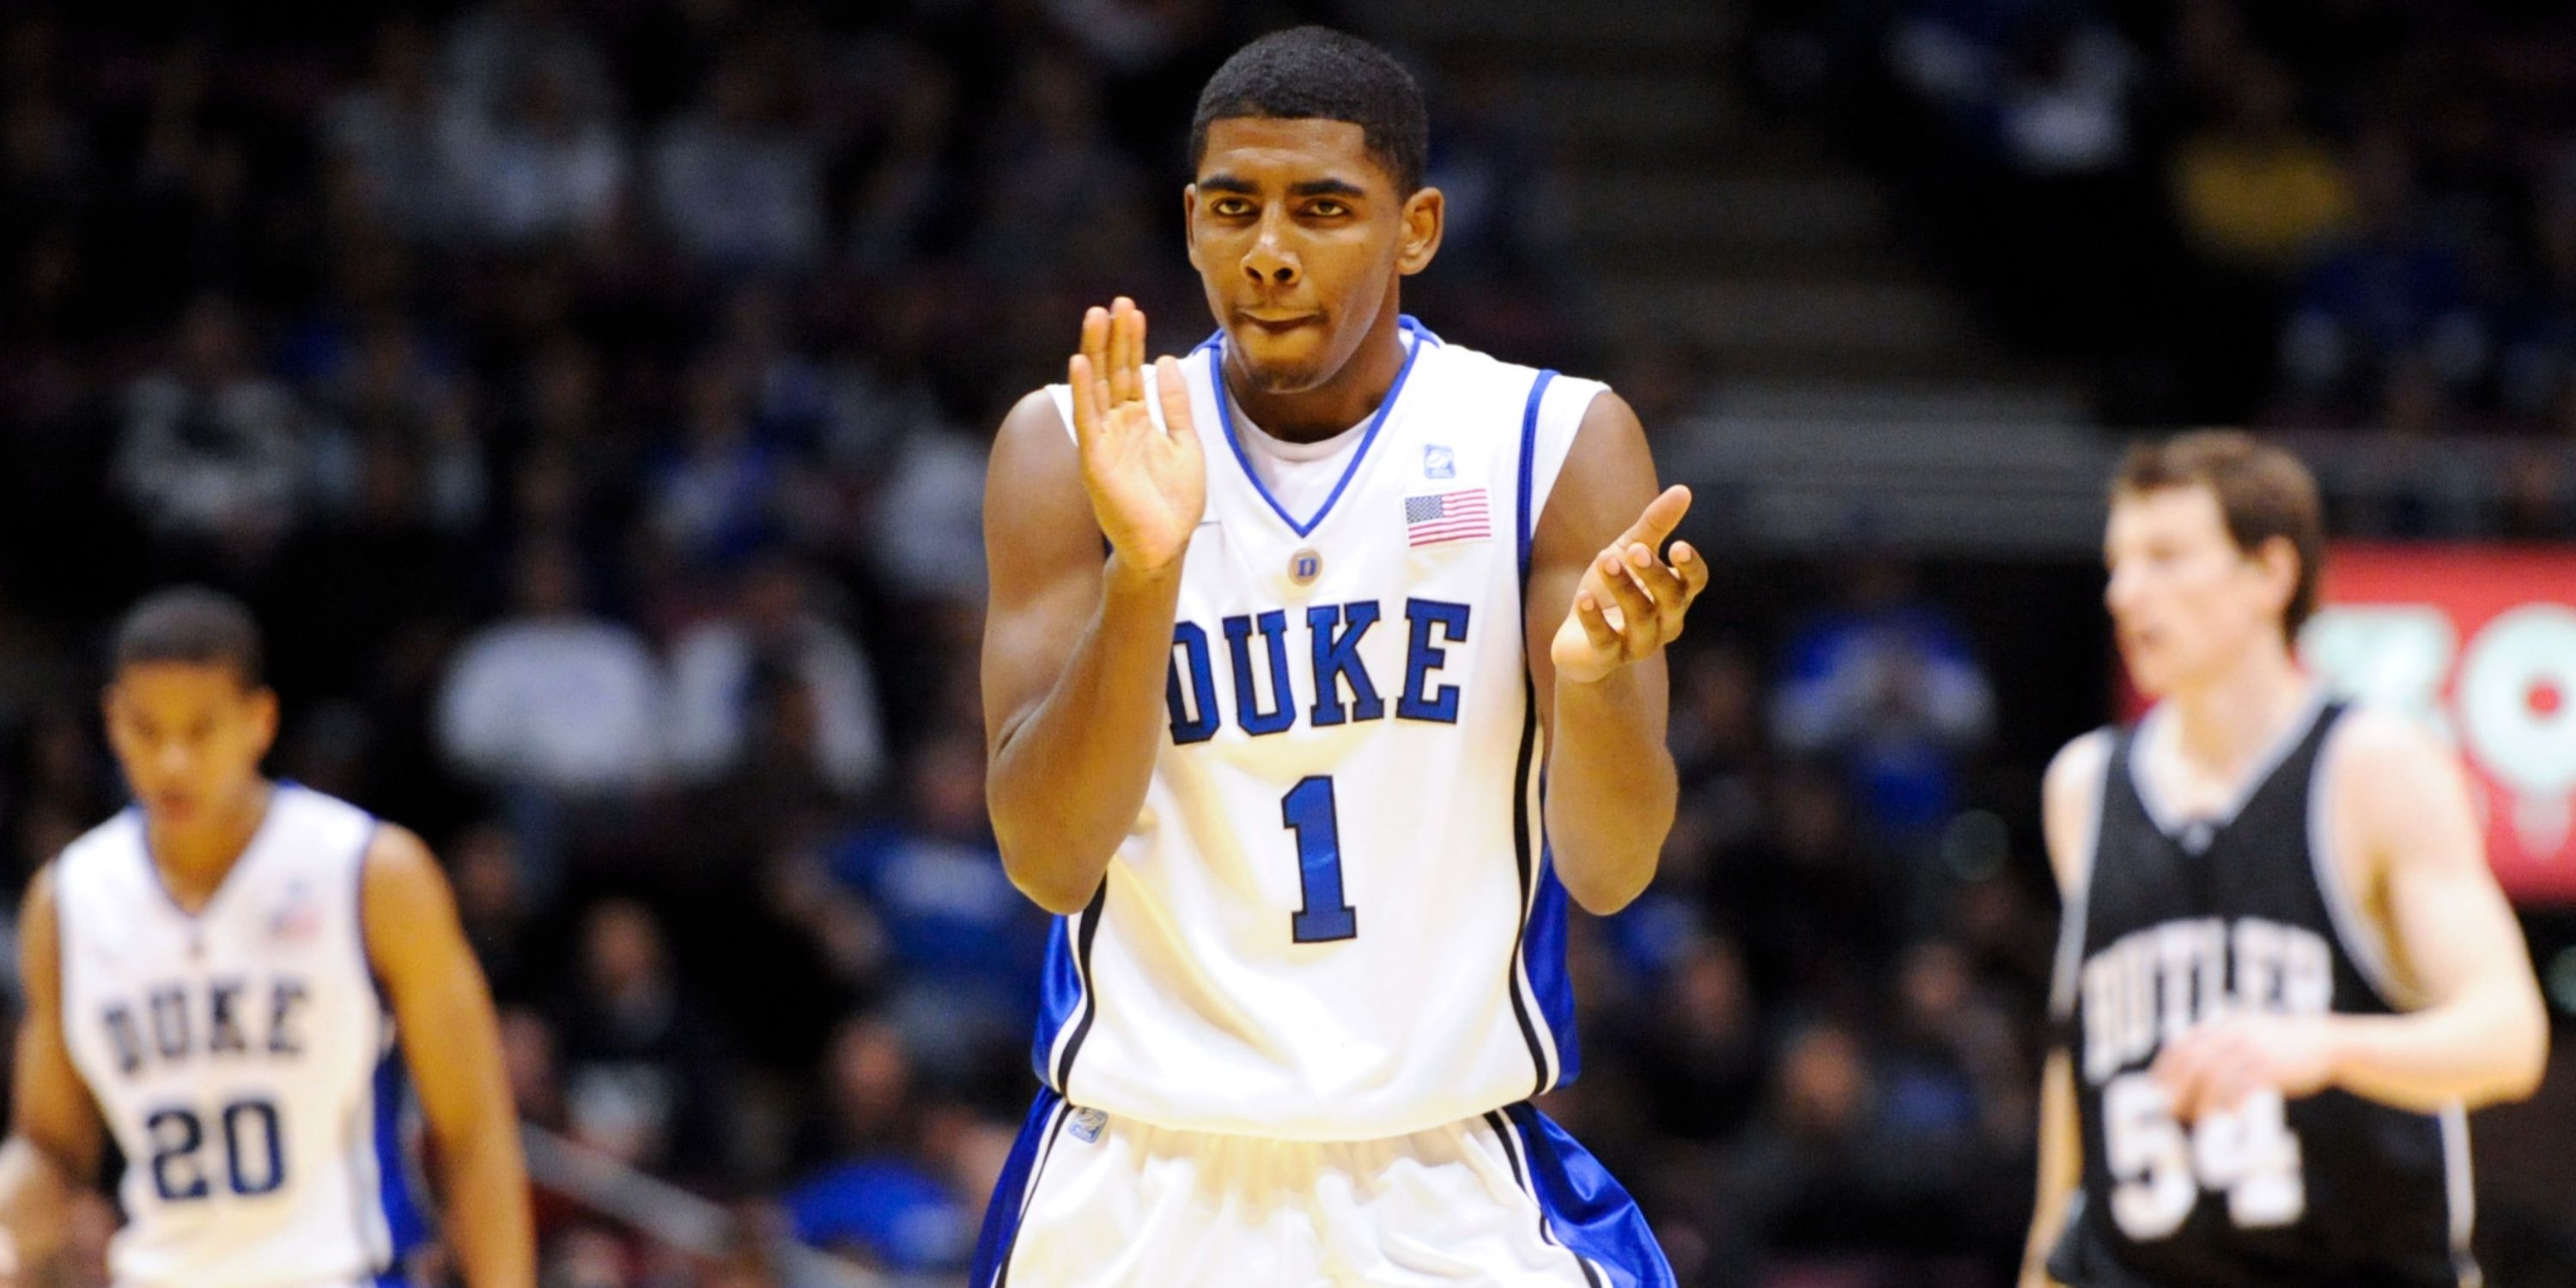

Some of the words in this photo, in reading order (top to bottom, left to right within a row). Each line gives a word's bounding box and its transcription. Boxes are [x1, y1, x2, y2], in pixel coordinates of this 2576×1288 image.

[1299, 557, 1317, 577] D
[1166, 597, 1470, 745] DUKE
[1281, 775, 1357, 944] 1
[102, 979, 309, 1076] DUKE
[2081, 915, 2335, 1084] BUTLER
[146, 1100, 284, 1200] 20
[2102, 1070, 2306, 1242] 54
